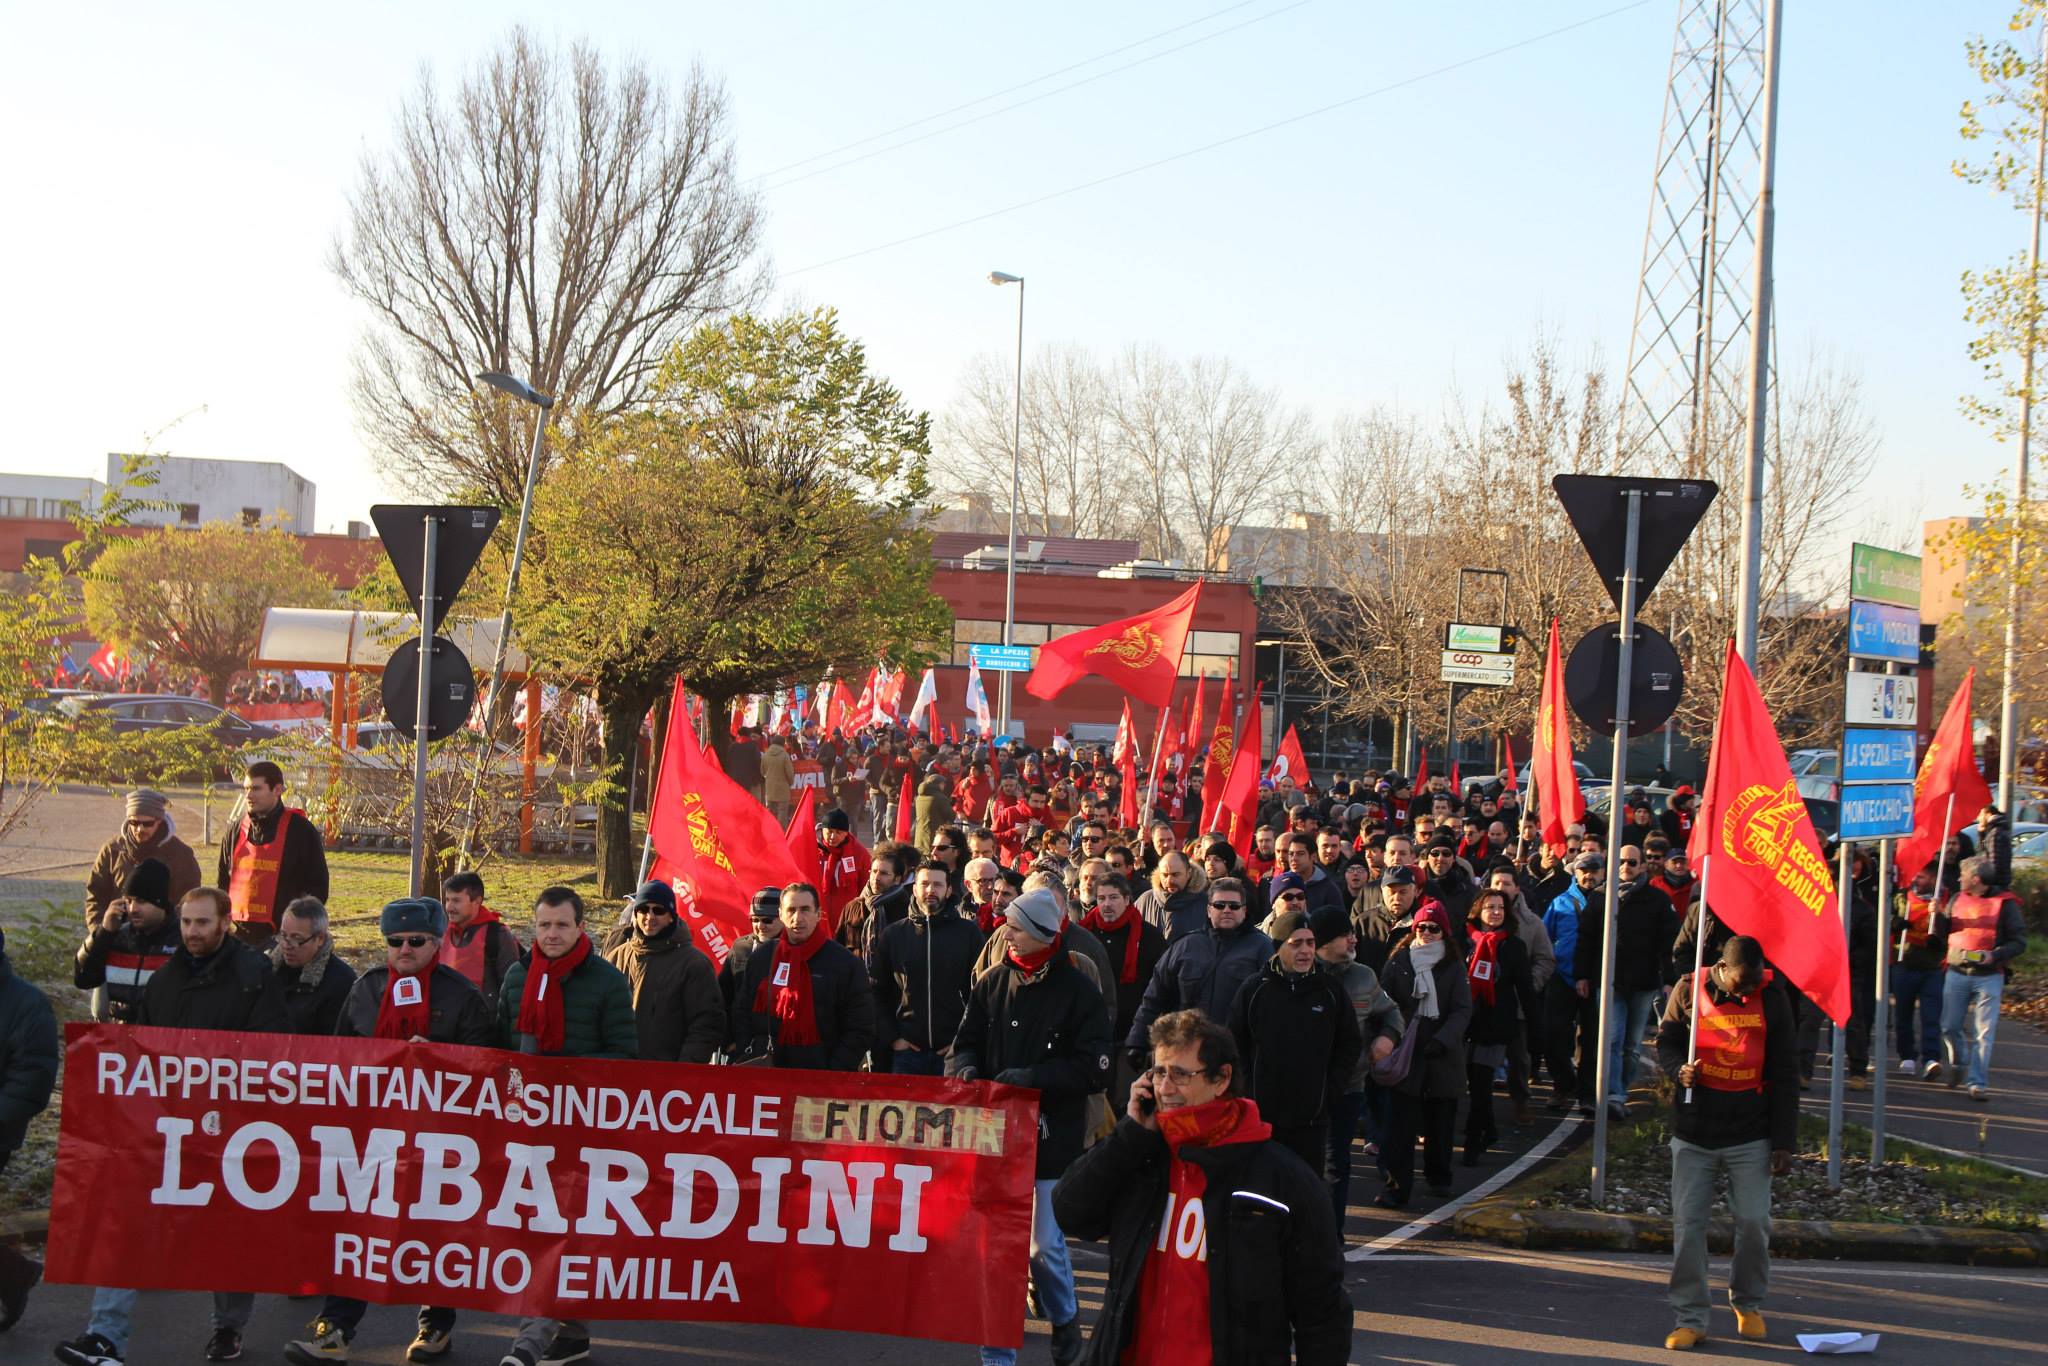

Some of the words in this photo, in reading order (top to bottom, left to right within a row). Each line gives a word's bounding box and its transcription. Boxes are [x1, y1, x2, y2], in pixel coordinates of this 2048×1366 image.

[1443, 670, 1490, 680] SUPERMERCATO
[1453, 653, 1483, 667] coop
[1846, 744, 1859, 767] LA
[1860, 742, 1890, 767] SPEZIA
[1842, 798, 1903, 824] MONTECCHIO
[1744, 832, 1779, 866] FIOM
[1788, 839, 1834, 893] REGGIO
[1775, 862, 1827, 917] EMILIA
[97, 1052, 504, 1120] RAPPRESENTANZA
[521, 1083, 781, 1137] SINDACALE
[824, 1101, 956, 1148] FIOM
[150, 1116, 933, 1253] LOMBARDINI
[333, 1233, 532, 1294] REGGIO
[556, 1255, 740, 1304] EMILIA
